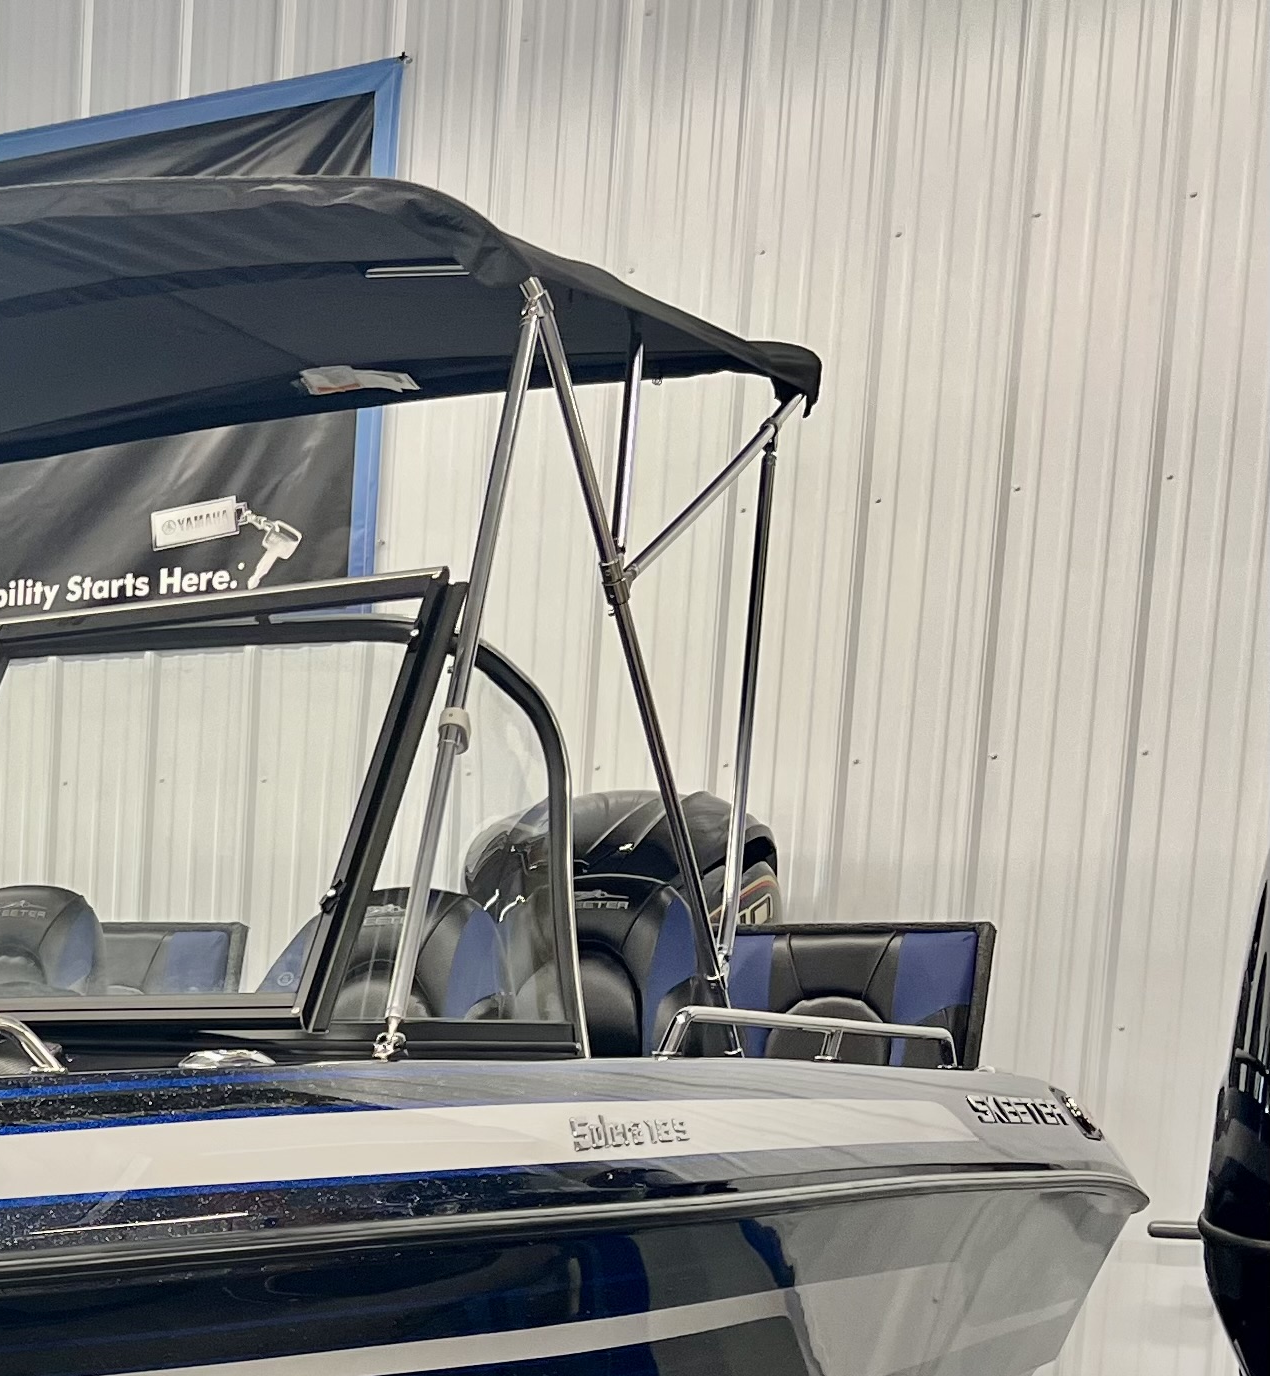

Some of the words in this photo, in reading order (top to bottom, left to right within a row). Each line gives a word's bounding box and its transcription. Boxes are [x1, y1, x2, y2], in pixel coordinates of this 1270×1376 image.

[177, 508, 230, 532] YAMAHA
[66, 574, 149, 602] Starts
[159, 567, 238, 595] Here.
[966, 1095, 1069, 1125] SKEETER
